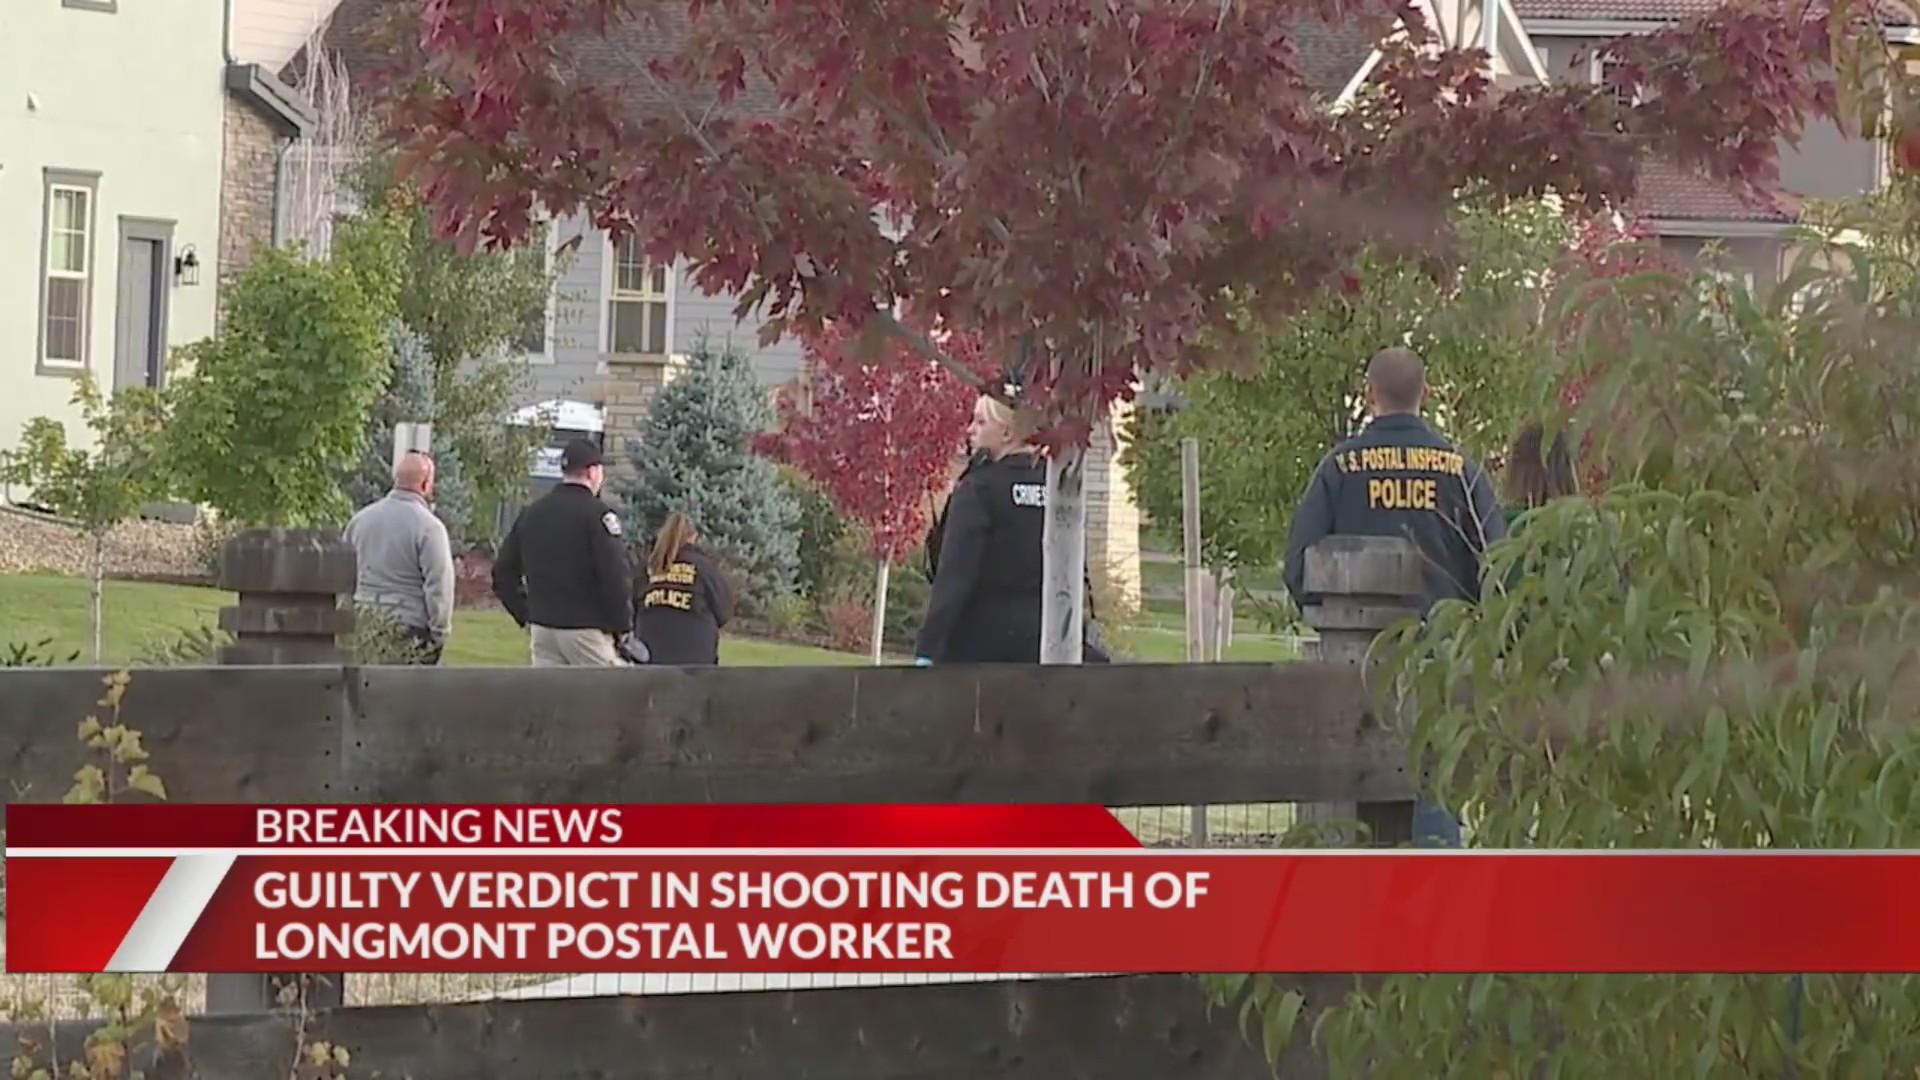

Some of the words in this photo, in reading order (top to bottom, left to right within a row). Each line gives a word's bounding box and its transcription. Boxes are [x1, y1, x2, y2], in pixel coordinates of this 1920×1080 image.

[1361, 447, 1404, 471] POSTAL
[1406, 447, 1463, 476] INSPECTOR
[1369, 479, 1437, 509] POLICE
[644, 589, 693, 610] POLICE
